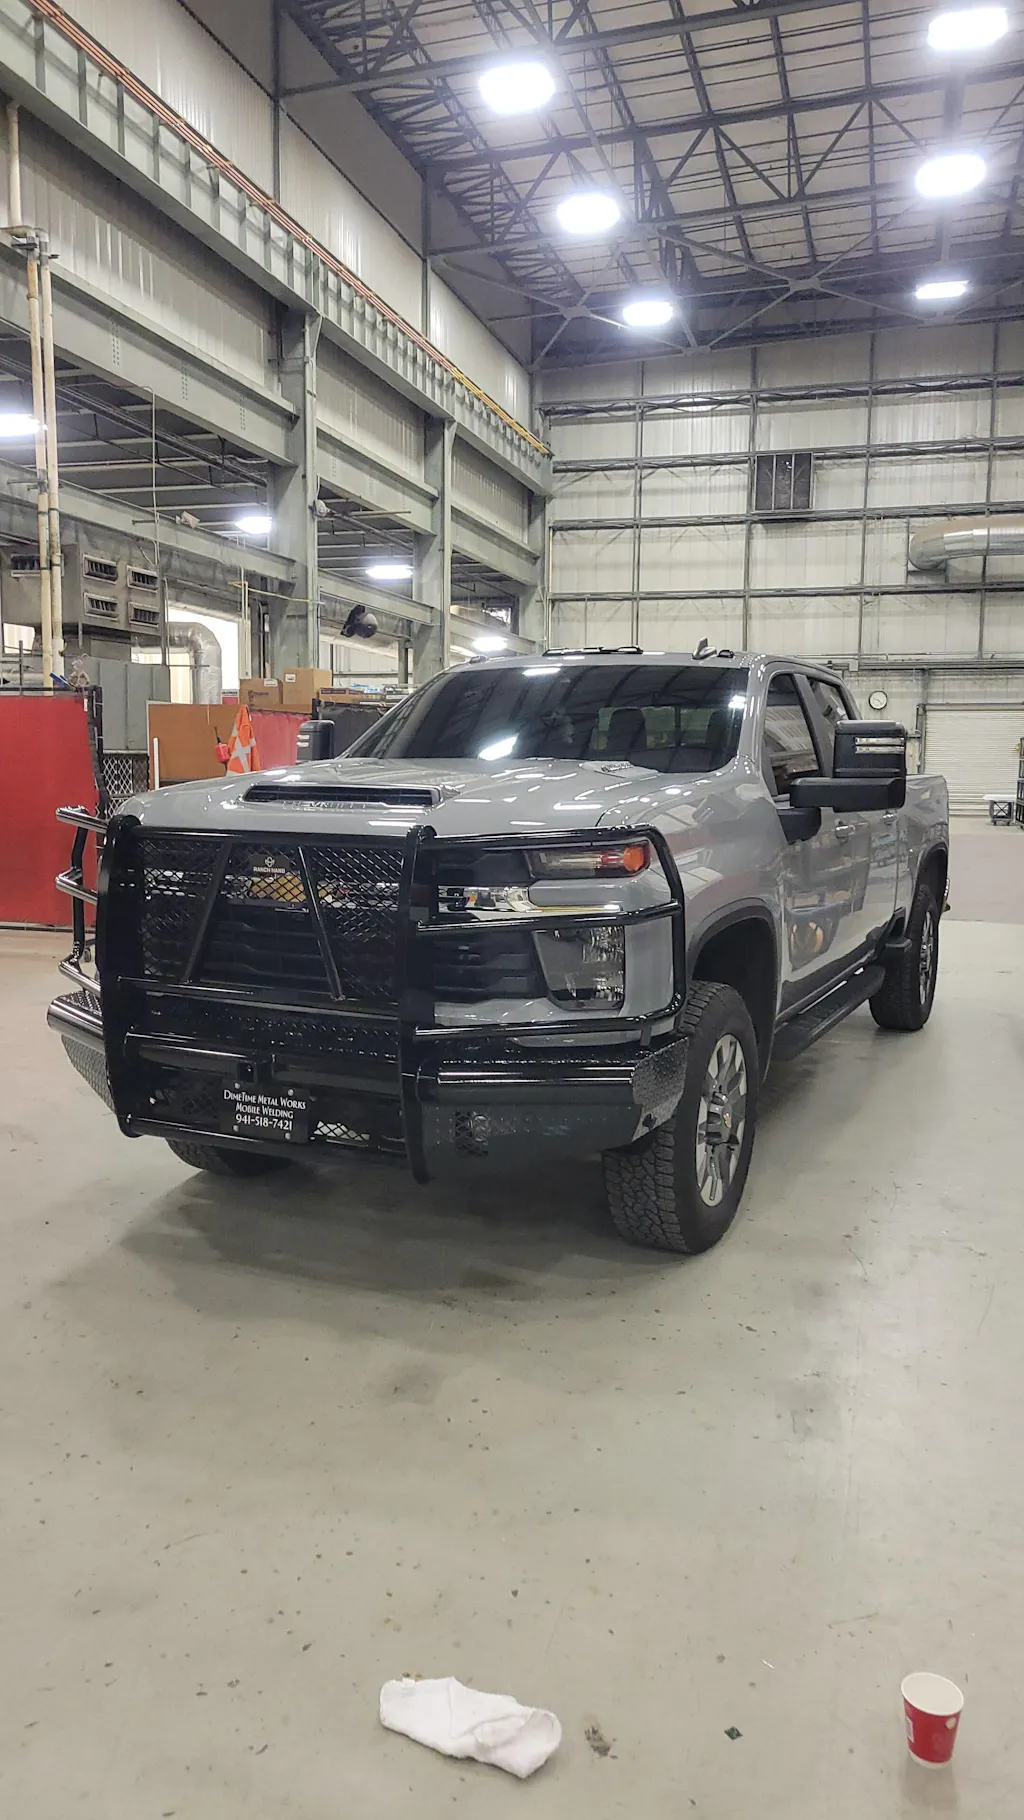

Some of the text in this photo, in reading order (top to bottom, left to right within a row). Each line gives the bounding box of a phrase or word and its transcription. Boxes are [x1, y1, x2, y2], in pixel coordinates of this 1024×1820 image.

[235, 1102, 293, 1119] MOBILE WELDING
[257, 1095, 278, 1106] METAL
[280, 1097, 306, 1110] WORKS
[235, 1114, 292, 1130] 941-518-7421
